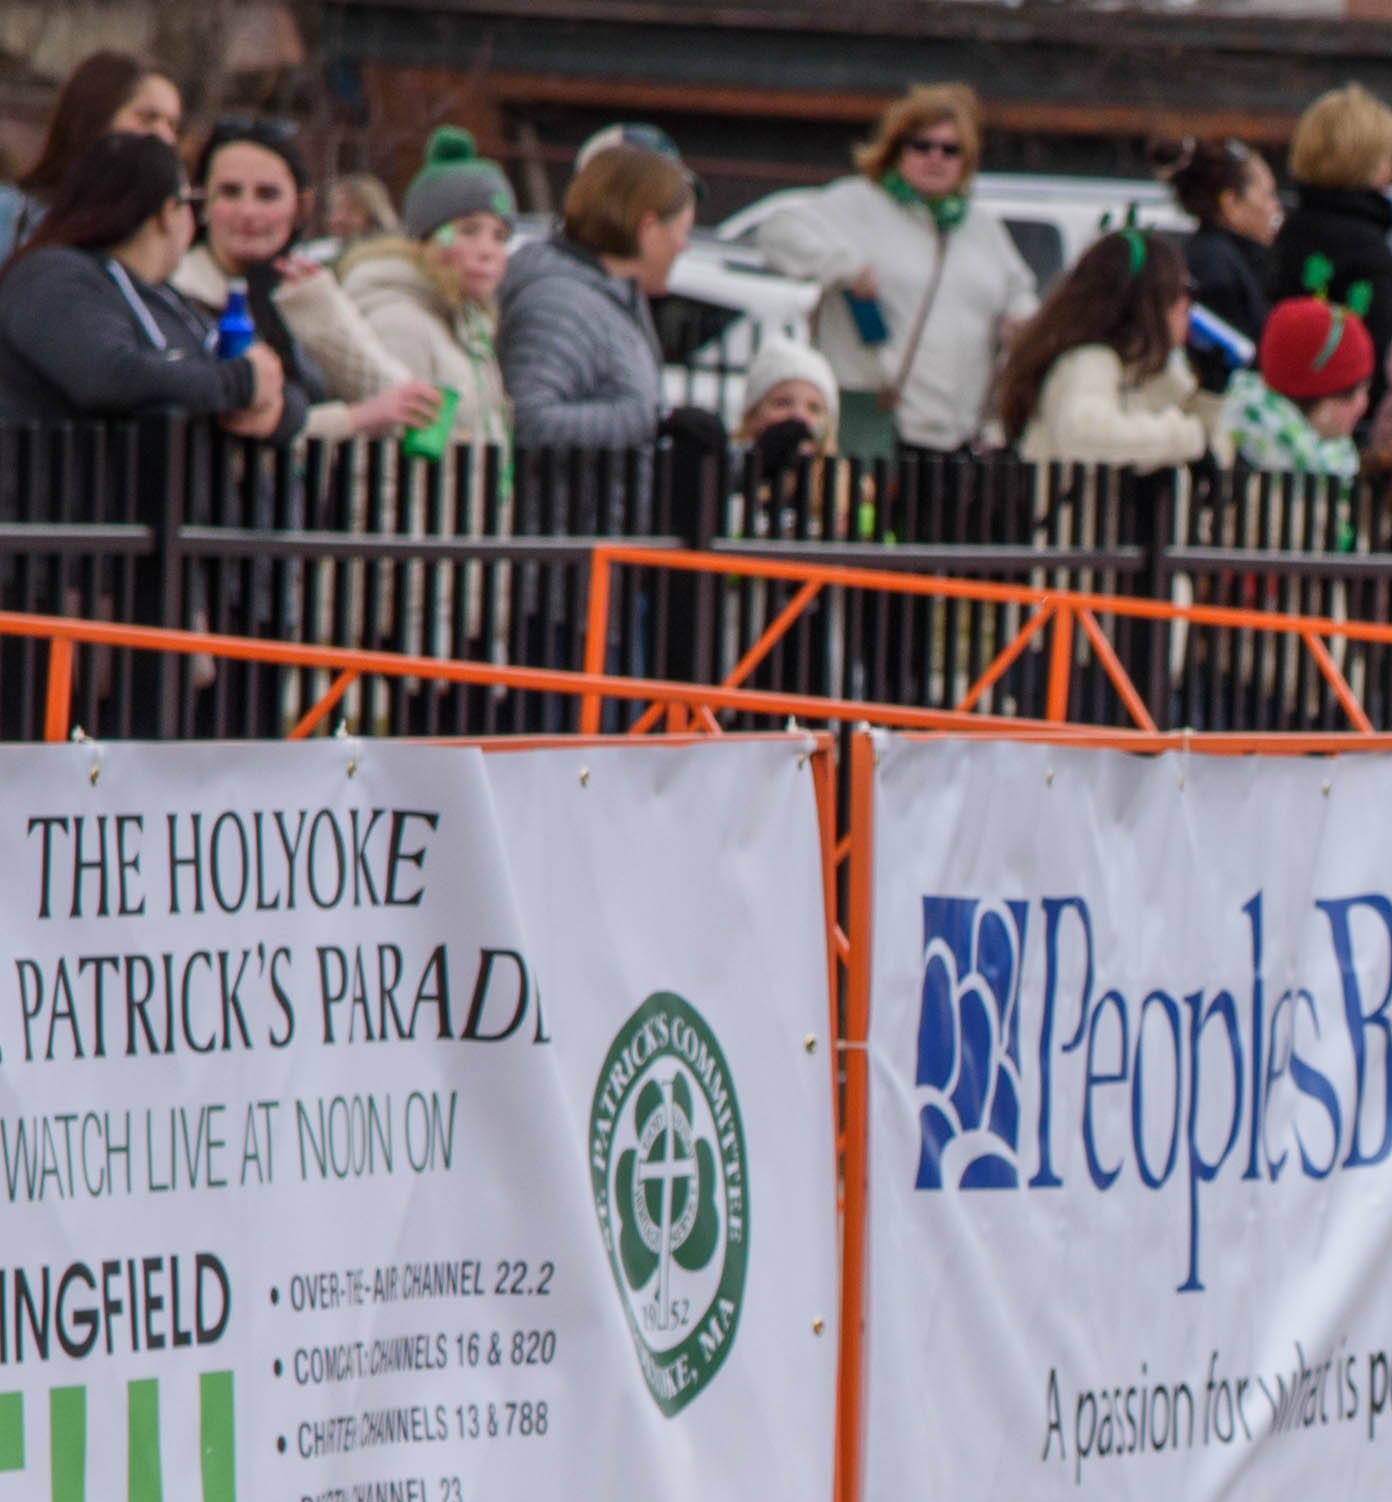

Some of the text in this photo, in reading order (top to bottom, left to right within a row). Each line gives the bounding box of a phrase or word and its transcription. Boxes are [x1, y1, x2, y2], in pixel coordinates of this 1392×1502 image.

[27, 808, 439, 919] THE HOLYOKE
[15, 941, 296, 1061] PATRICK'S
[0, 1088, 458, 1202] WATCH LIVE AT NOON ON
[290, 1259, 555, 1312] OVER-TE-AIR CHANNEL 22.2
[370, 1332, 448, 1377] CHANNELS
[456, 1331, 481, 1368] 16
[487, 1331, 502, 1367] &
[510, 1330, 557, 1366] 820
[698, 1298, 735, 1363] MA
[360, 1404, 448, 1450] CHANNELS
[456, 1402, 480, 1440] 13
[488, 1402, 499, 1438] &
[505, 1400, 549, 1437] 788
[1043, 1367, 1067, 1462] A
[1075, 1362, 1194, 1485] passion
[1202, 1349, 1252, 1446] for
[1335, 1336, 1358, 1421] is
